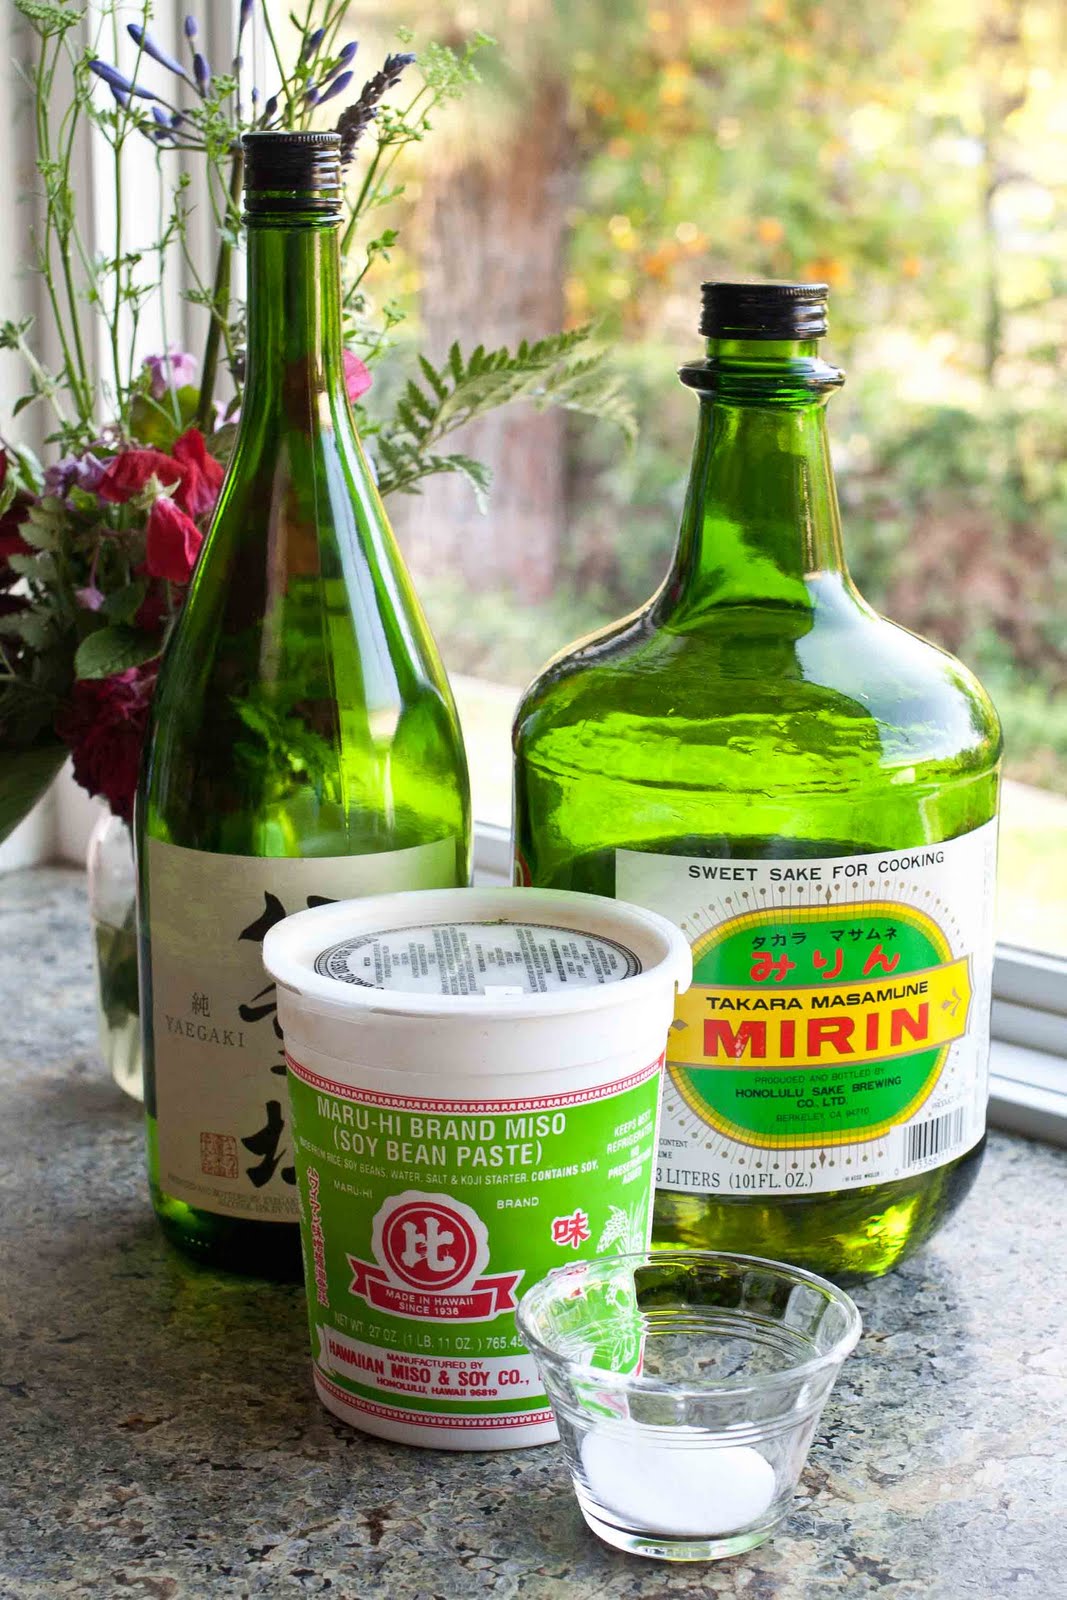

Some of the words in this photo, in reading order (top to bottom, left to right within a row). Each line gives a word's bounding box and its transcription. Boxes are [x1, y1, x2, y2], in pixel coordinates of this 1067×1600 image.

[688, 865, 758, 882] SWEET
[769, 867, 822, 881] SAKE
[832, 863, 868, 879] FOR
[878, 851, 945, 874] COOKING
[751, 931, 807, 950] タカラ
[830, 927, 898, 943] マサムネ
[750, 944, 900, 983] みりん
[705, 996, 802, 1012] TAKARA
[811, 981, 929, 1010] MASAMUNE
[165, 1014, 244, 1048] YAEGAKI
[703, 1002, 930, 1059] MIRIN
[735, 1088, 804, 1098] HONOLULU
[811, 1085, 845, 1097] SAKE
[852, 1076, 902, 1093] BREWING
[754, 1075, 805, 1085] PRODUCED
[810, 1074, 828, 1083] AND
[831, 1068, 871, 1081] BOTTLED
[874, 1067, 885, 1076] BY
[317, 1095, 401, 1136] MARU-HI
[410, 1117, 496, 1141] BRAND
[505, 1113, 566, 1140] MISO
[829, 1110, 842, 1120] CA
[333, 1125, 378, 1157] (SOY
[386, 1140, 446, 1167] BEAN
[457, 1140, 542, 1168] PASTE)
[659, 1138, 688, 1149] CONTENT
[344, 1158, 357, 1171] SOY
[426, 1173, 447, 1185] SALT
[451, 1176, 459, 1185] &
[460, 1174, 482, 1186] KOJI
[531, 1164, 578, 1182] CONTAINS
[667, 1168, 721, 1188] LITERS
[333, 1180, 373, 1199] MARU-HI
[496, 1196, 540, 1210] BRAND
[552, 1209, 591, 1249] 味
[385, 1288, 416, 1304] MADE
[419, 1296, 431, 1305] IN
[434, 1297, 474, 1306] HAWAII
[399, 1302, 430, 1314] SINCE
[334, 1312, 348, 1328] NET
[369, 1326, 381, 1339] 27
[438, 1337, 450, 1349] 11
[328, 1339, 385, 1375] HAWAIIAN
[391, 1363, 431, 1384] MISO
[438, 1371, 450, 1386] &
[458, 1371, 490, 1387] SOY
[386, 1353, 467, 1369] MANUFACTURED
[470, 1361, 483, 1370] BY
[431, 1388, 467, 1397] HAWAII
[470, 1388, 498, 1397] 96819
